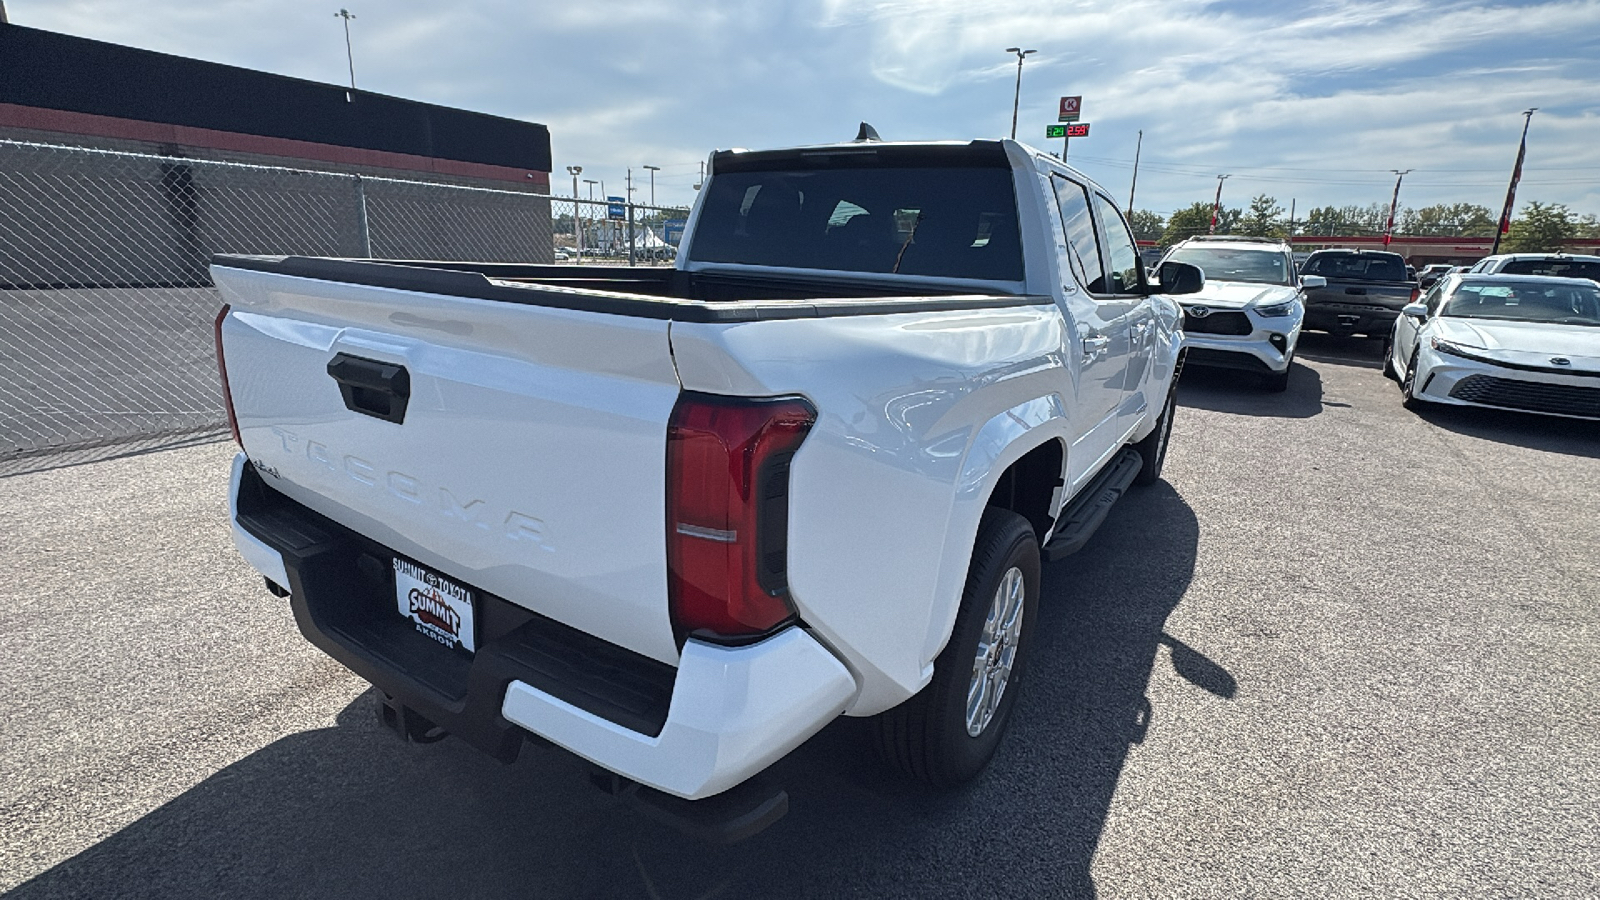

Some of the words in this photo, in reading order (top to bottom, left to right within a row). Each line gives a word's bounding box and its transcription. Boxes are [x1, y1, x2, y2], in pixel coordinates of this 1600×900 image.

[272, 426, 556, 552] TACOMA
[393, 557, 426, 582] SUMMIT
[438, 577, 471, 605] TOYOTA
[410, 590, 459, 635] SUMMIT
[416, 624, 454, 649] AKRON
